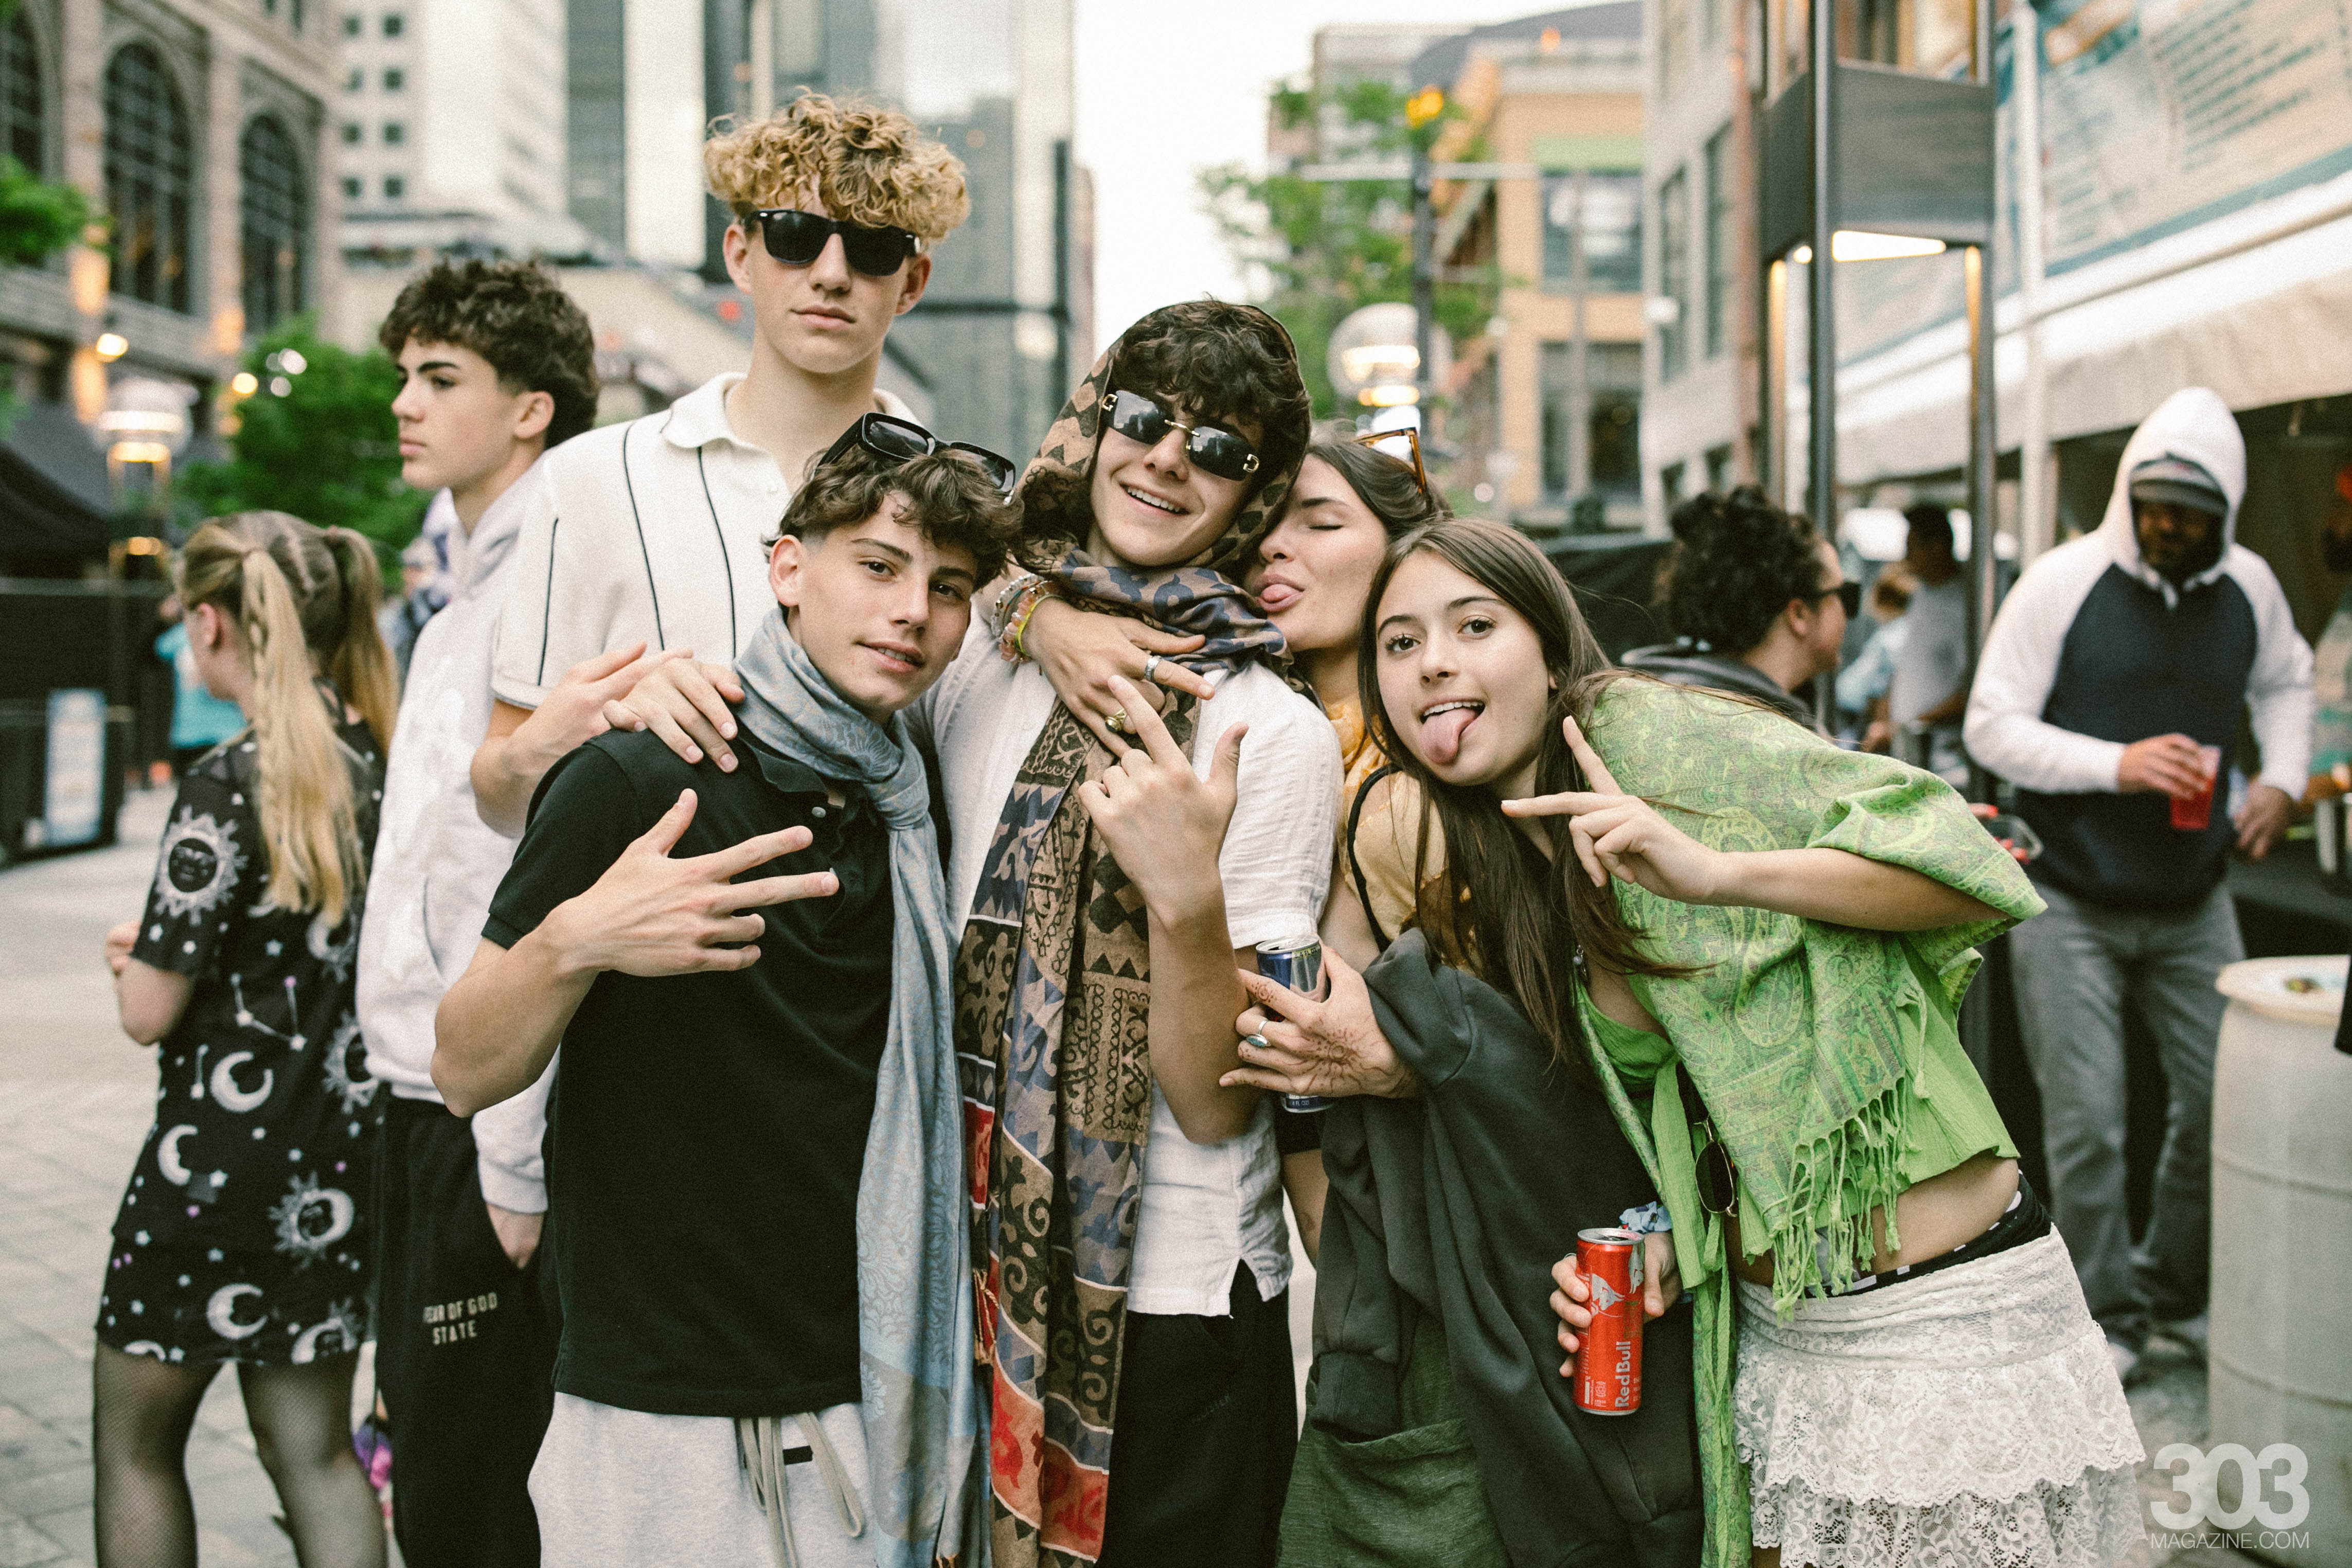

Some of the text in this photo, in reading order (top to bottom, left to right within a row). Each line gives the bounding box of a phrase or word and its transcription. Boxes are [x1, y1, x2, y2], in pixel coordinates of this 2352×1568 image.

[447, 1300, 463, 1320] OF
[467, 1292, 498, 1315] GOD
[433, 1320, 477, 1345] STATE
[1615, 1341, 1631, 1407] Red Bull
